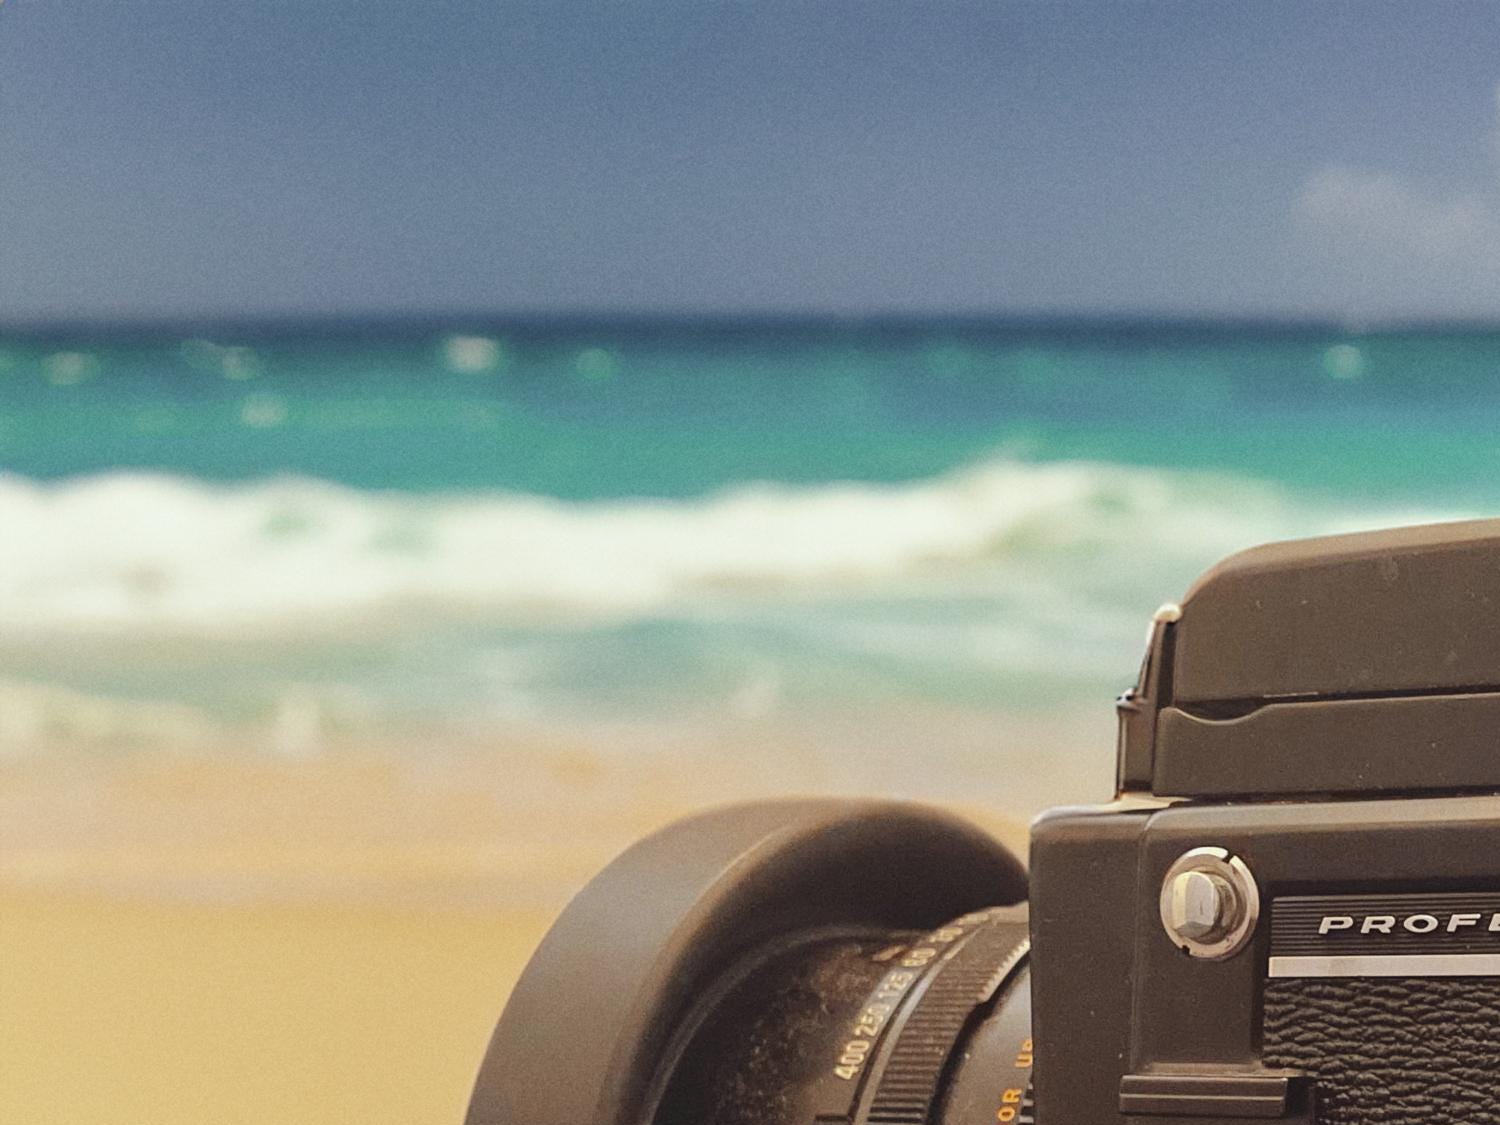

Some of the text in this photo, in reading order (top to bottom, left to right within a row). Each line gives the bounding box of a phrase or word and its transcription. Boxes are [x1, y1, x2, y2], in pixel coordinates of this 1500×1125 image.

[833, 1039, 870, 1080] 400
[854, 1002, 892, 1037] 250
[877, 970, 914, 999] 125
